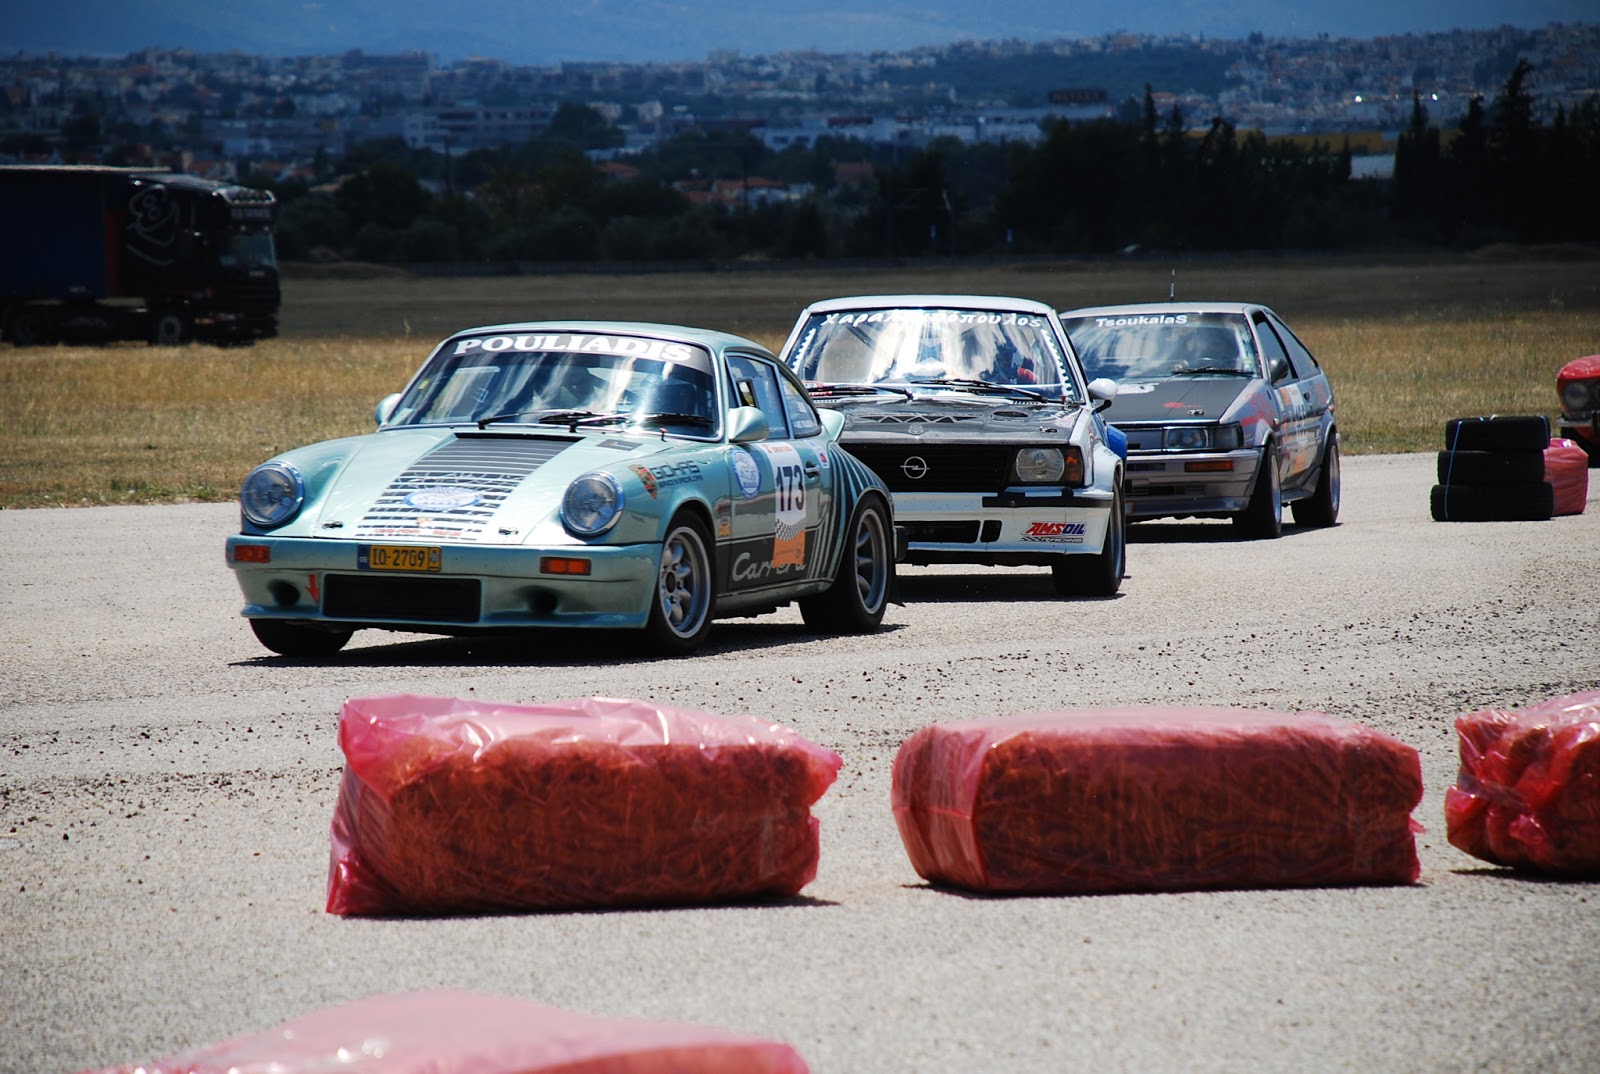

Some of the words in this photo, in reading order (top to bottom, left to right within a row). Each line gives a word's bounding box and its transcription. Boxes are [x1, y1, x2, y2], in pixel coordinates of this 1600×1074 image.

[1095, 314, 1188, 328] TsoukalaS
[453, 335, 692, 362] POULIADIS
[776, 464, 805, 512] 173
[1024, 522, 1086, 536] AMSOIL
